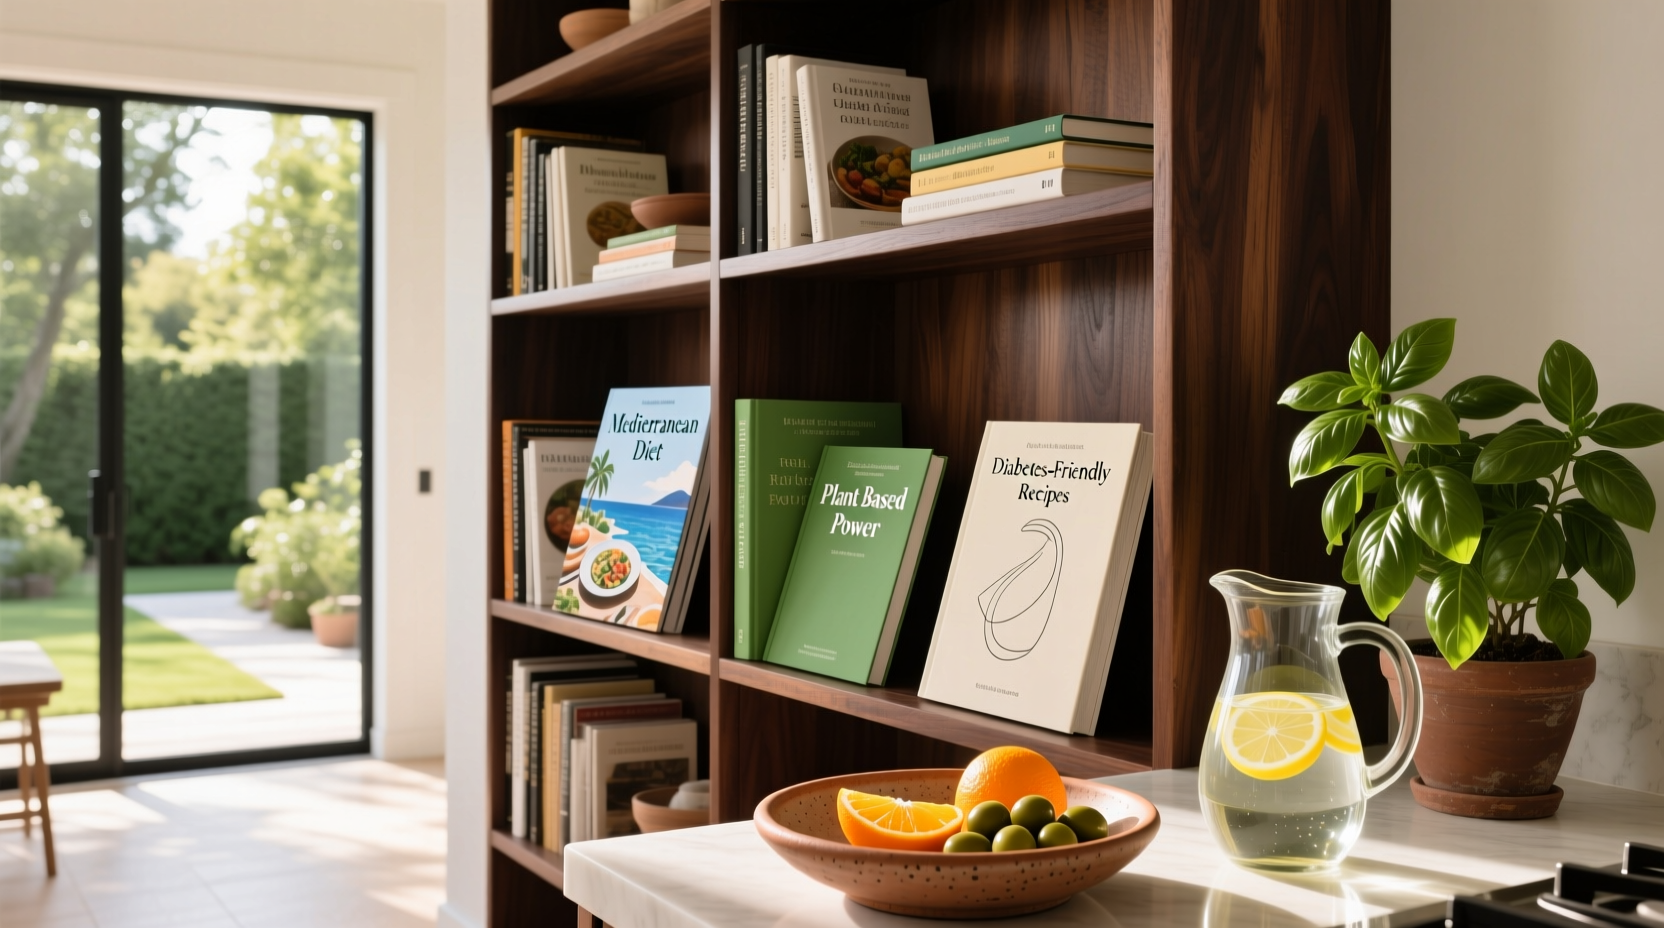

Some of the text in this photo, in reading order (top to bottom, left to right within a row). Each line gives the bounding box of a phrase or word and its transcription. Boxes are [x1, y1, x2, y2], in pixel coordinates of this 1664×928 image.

[632, 440, 664, 461] Diet
[992, 457, 1112, 486] Diabetes-Friendly
[820, 484, 860, 507] Plant
[861, 486, 909, 511] Based
[1018, 483, 1070, 508] Recipes
[830, 513, 882, 538] Power
